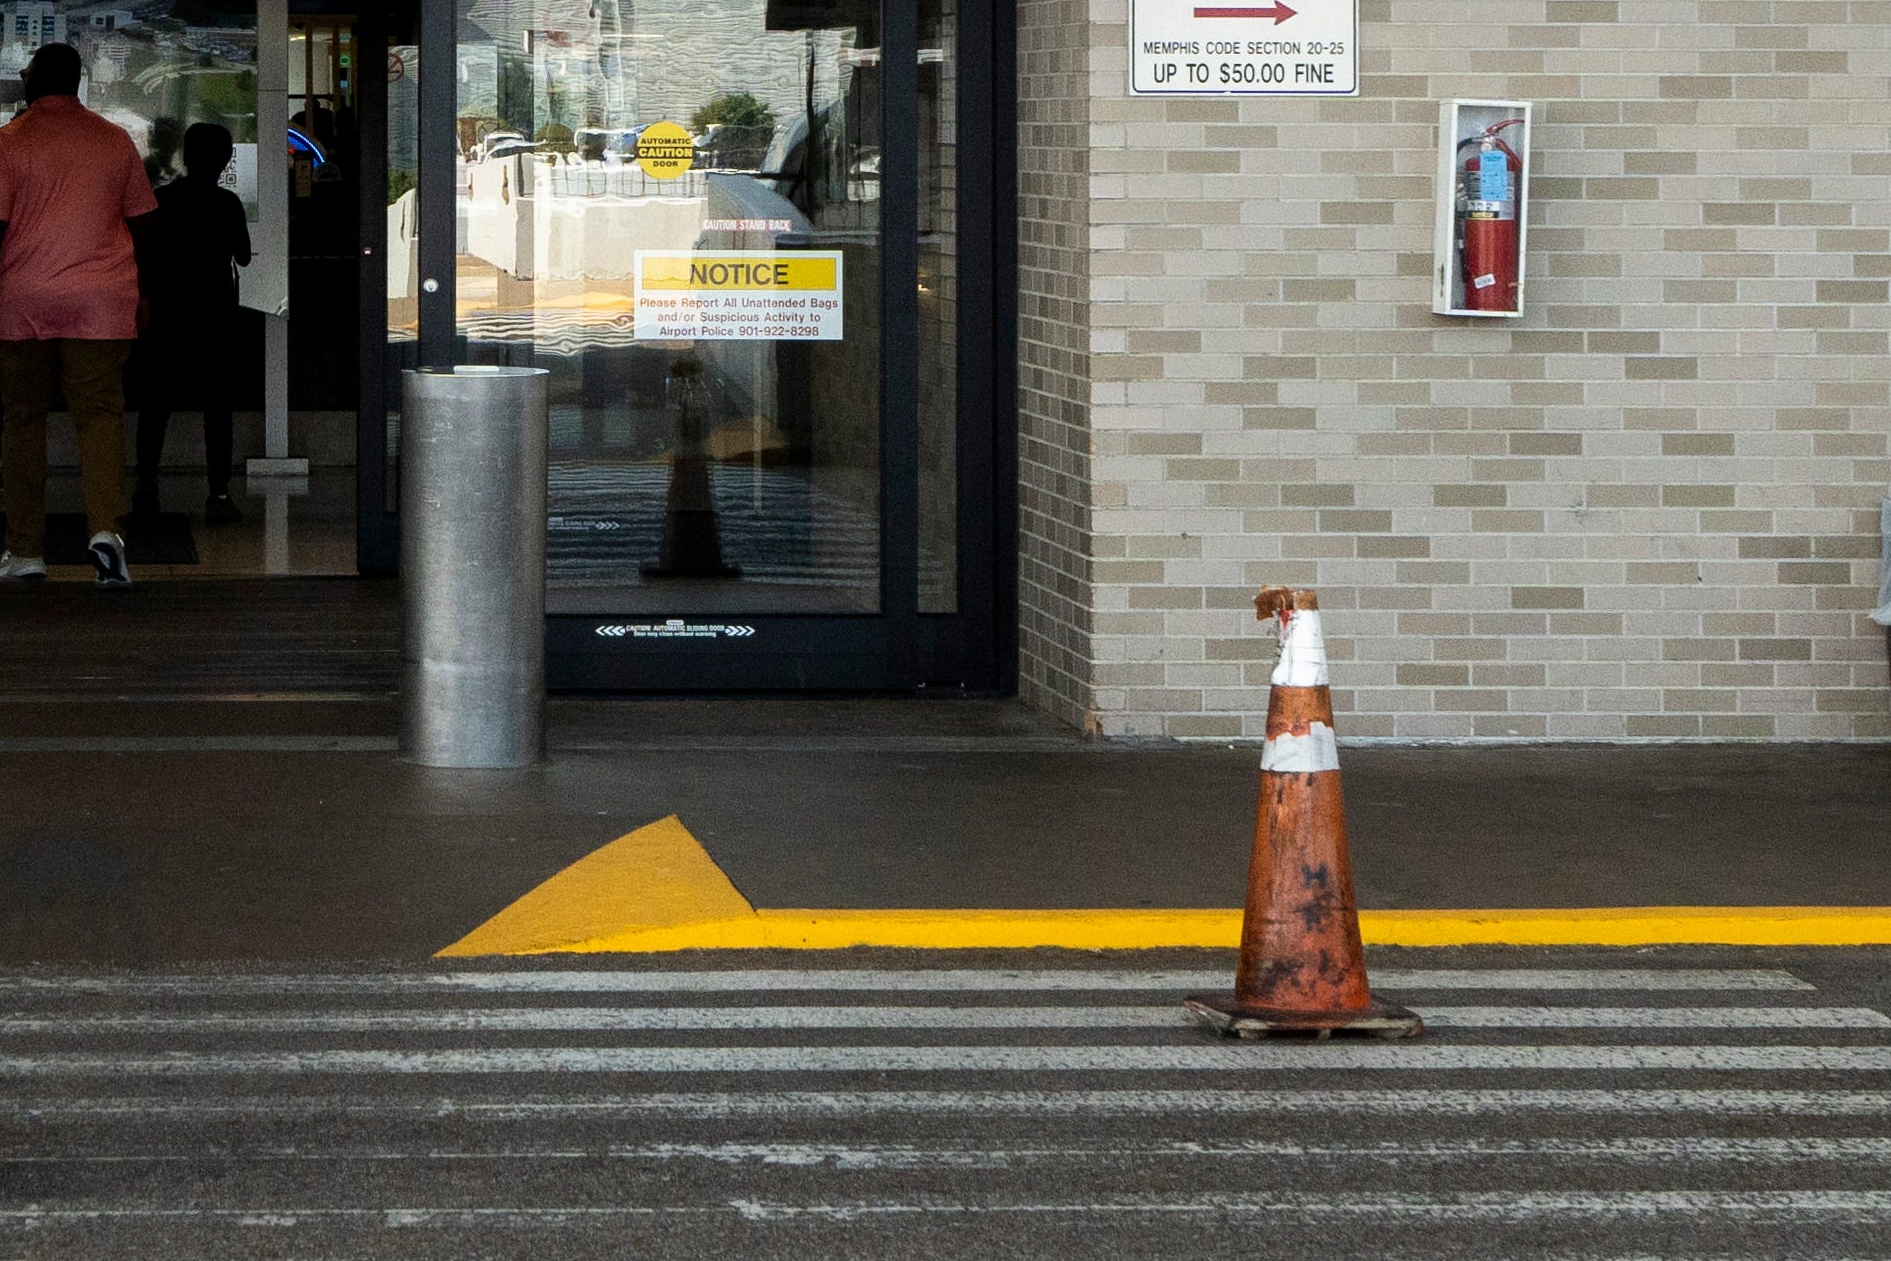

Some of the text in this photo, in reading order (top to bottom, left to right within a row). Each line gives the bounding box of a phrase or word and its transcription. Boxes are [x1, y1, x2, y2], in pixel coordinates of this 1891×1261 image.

[1143, 42, 1344, 54] MEMPHIS CODE SECTION 20-25
[1154, 63, 1334, 83] UP TO $50.00 FINE
[638, 148, 693, 158] CAUTION
[703, 219, 791, 231] CAUTION STAND BACK
[689, 263, 789, 285] NOTICE
[640, 298, 838, 311] Please Report All Unattended Bags
[657, 312, 821, 325] and/or Suspicious Activity to
[660, 326, 819, 339] Airport Police 901-922-8298
